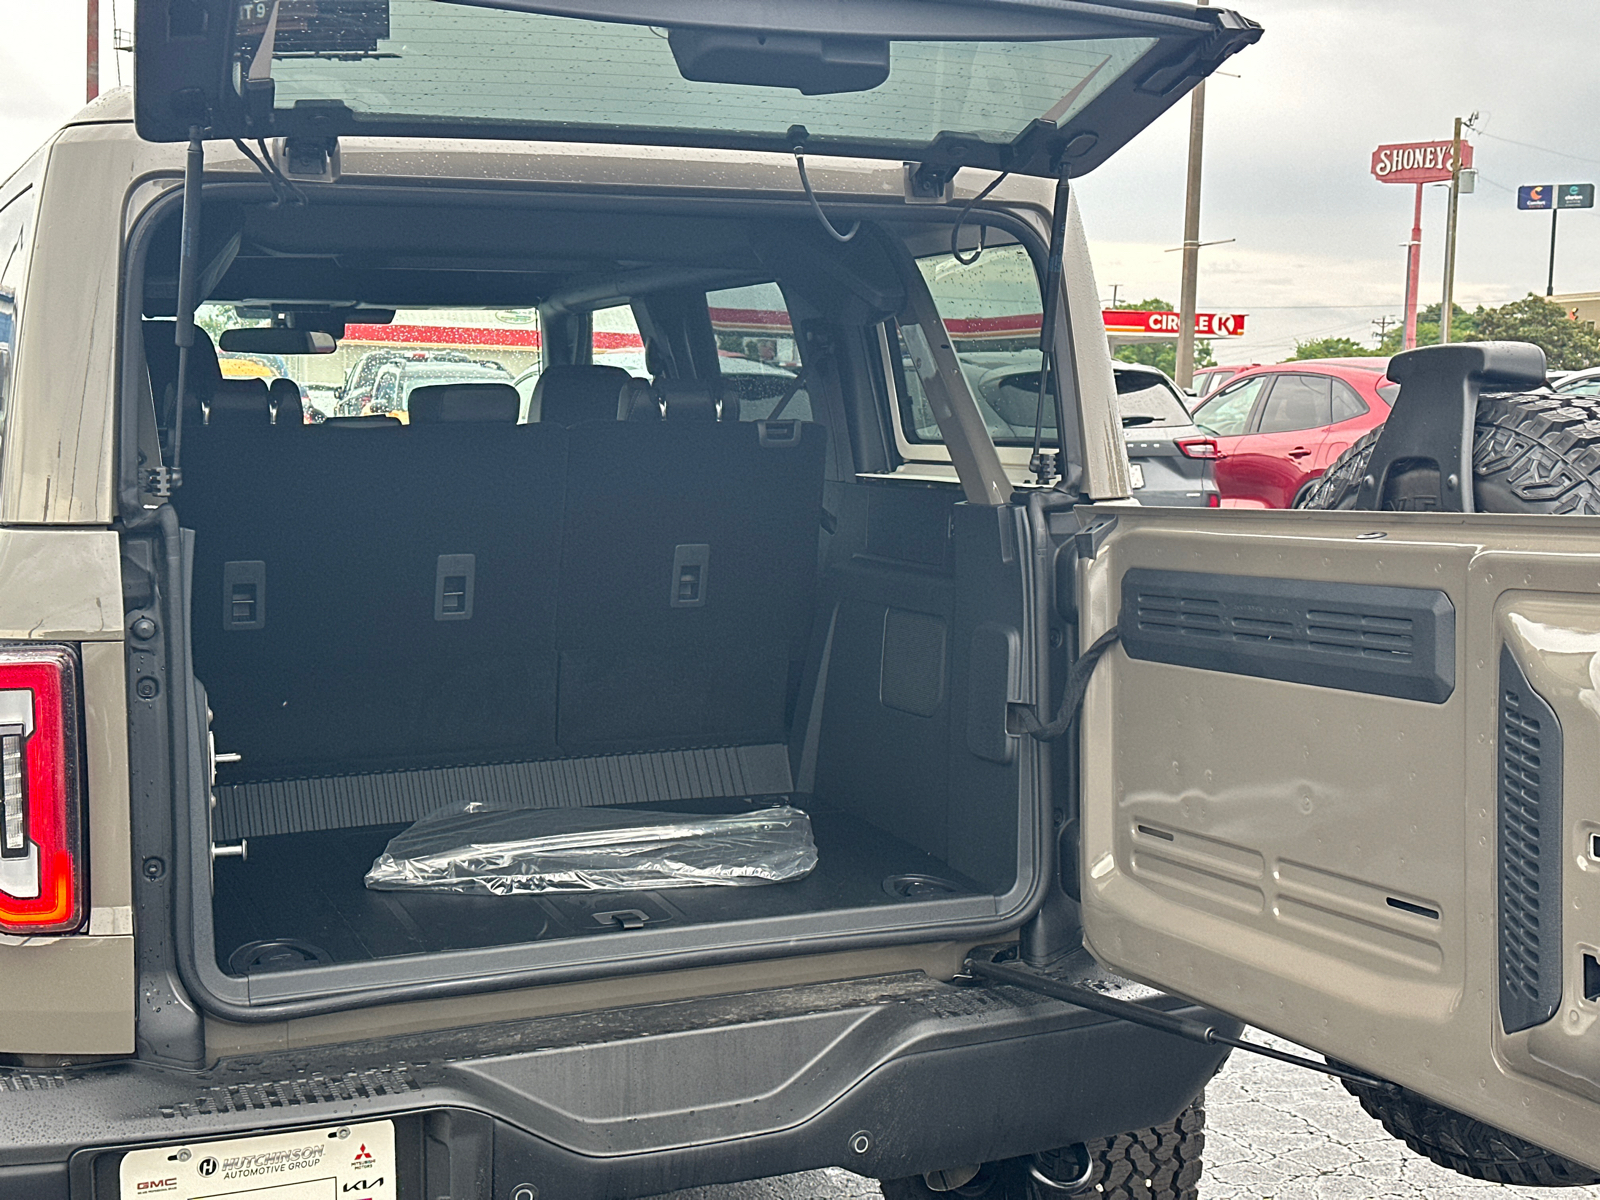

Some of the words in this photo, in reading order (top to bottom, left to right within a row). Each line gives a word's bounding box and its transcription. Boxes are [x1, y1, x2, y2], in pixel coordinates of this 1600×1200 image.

[256, 3, 266, 18] 9
[1218, 317, 1231, 335] K
[221, 1144, 325, 1171] HUTCHINSON
[224, 1163, 286, 1180] AUTOMOTIVE
[288, 1158, 320, 1171] GROUP
[137, 1177, 177, 1190] GMC
[343, 1176, 384, 1193] KIA
